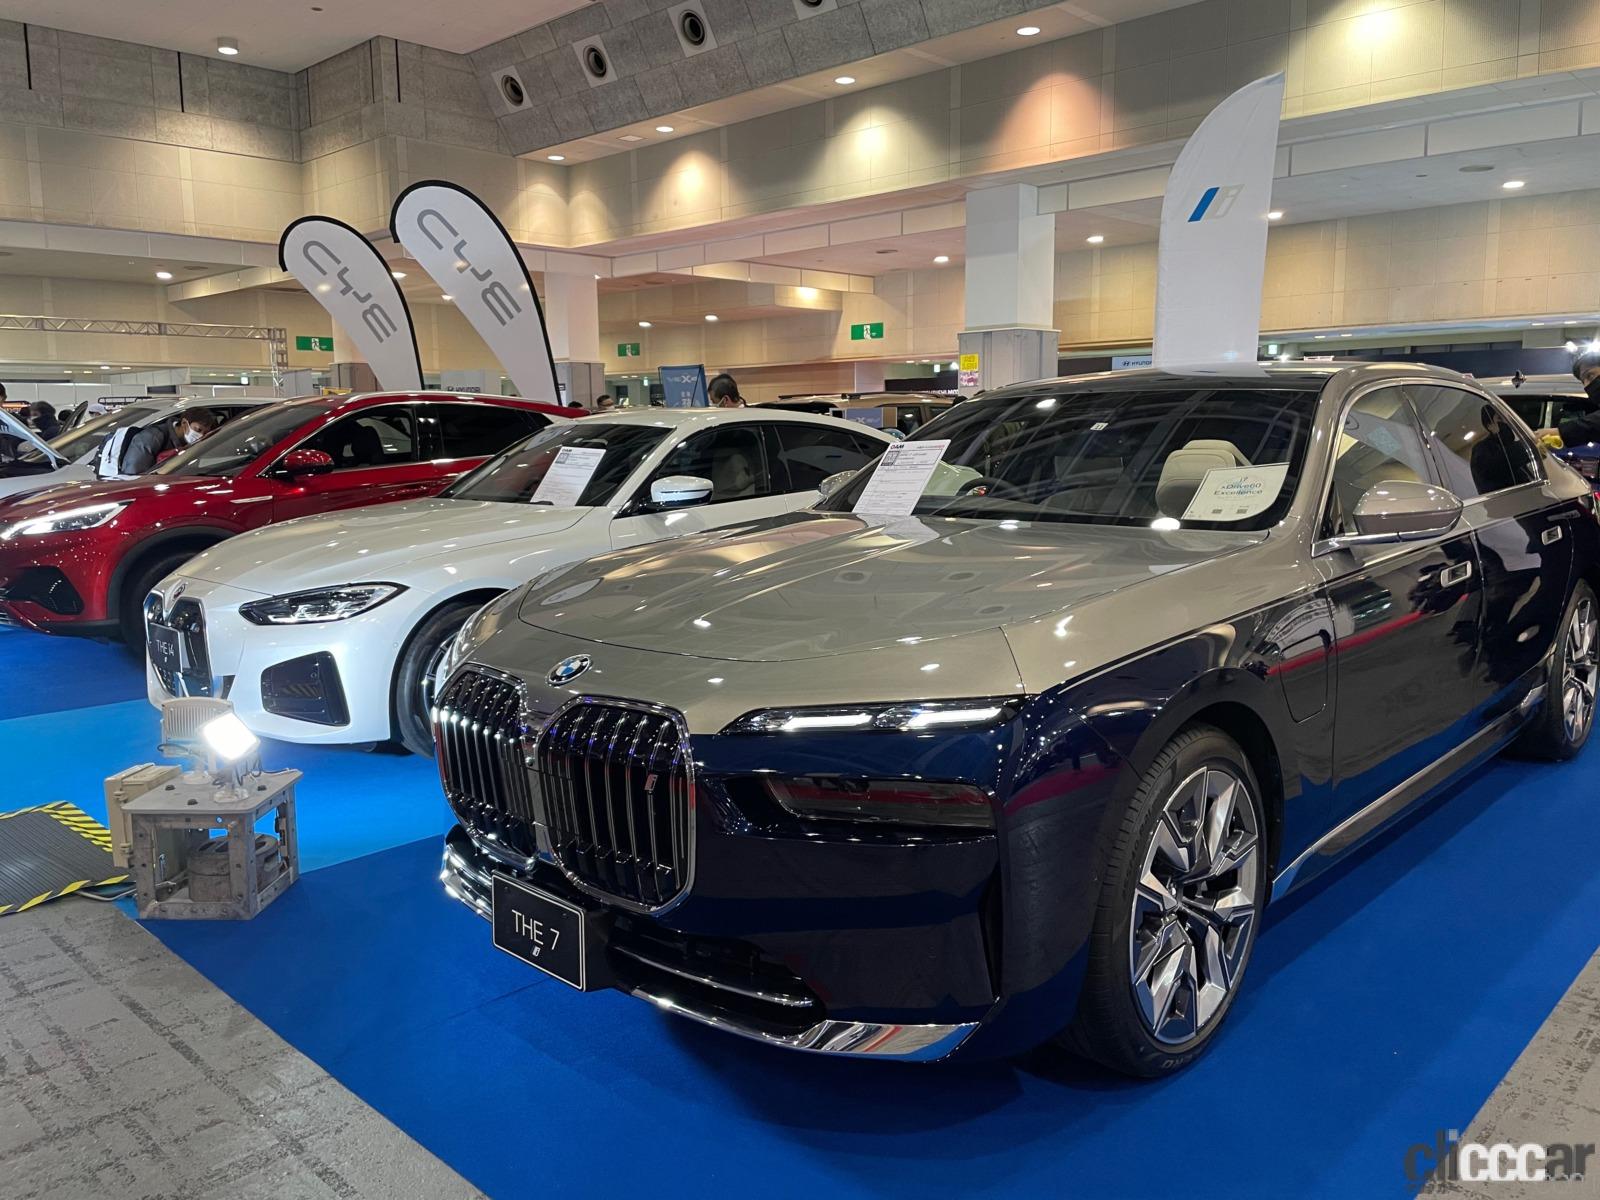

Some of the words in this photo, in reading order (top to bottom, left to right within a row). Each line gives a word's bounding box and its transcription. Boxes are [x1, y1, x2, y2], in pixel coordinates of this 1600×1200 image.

[156, 640, 168, 655] THE
[511, 908, 544, 945] THE
[549, 927, 560, 950] 7
